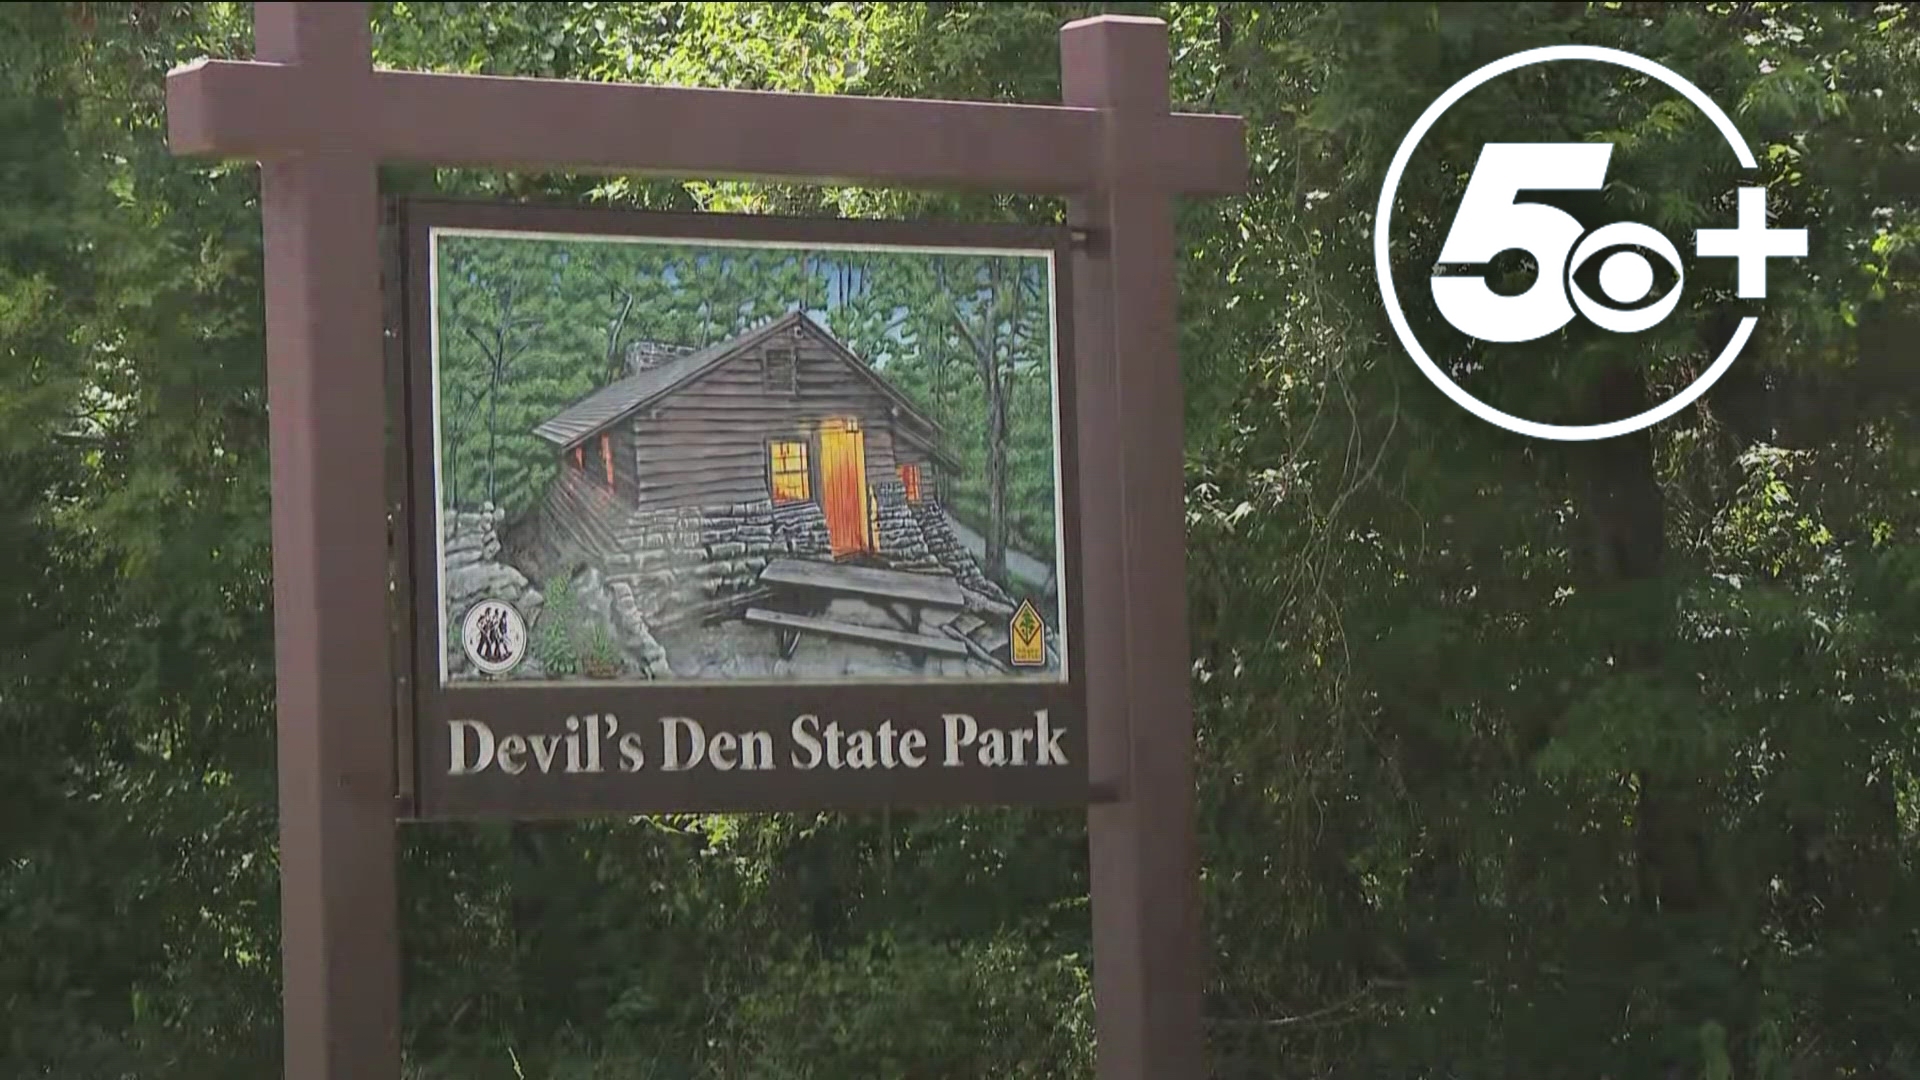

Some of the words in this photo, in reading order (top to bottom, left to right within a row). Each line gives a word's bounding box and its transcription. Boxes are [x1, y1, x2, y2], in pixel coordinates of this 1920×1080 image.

[447, 713, 645, 775] Devil's
[658, 716, 776, 772] Den
[791, 713, 927, 770] State
[941, 708, 1070, 768] Park
